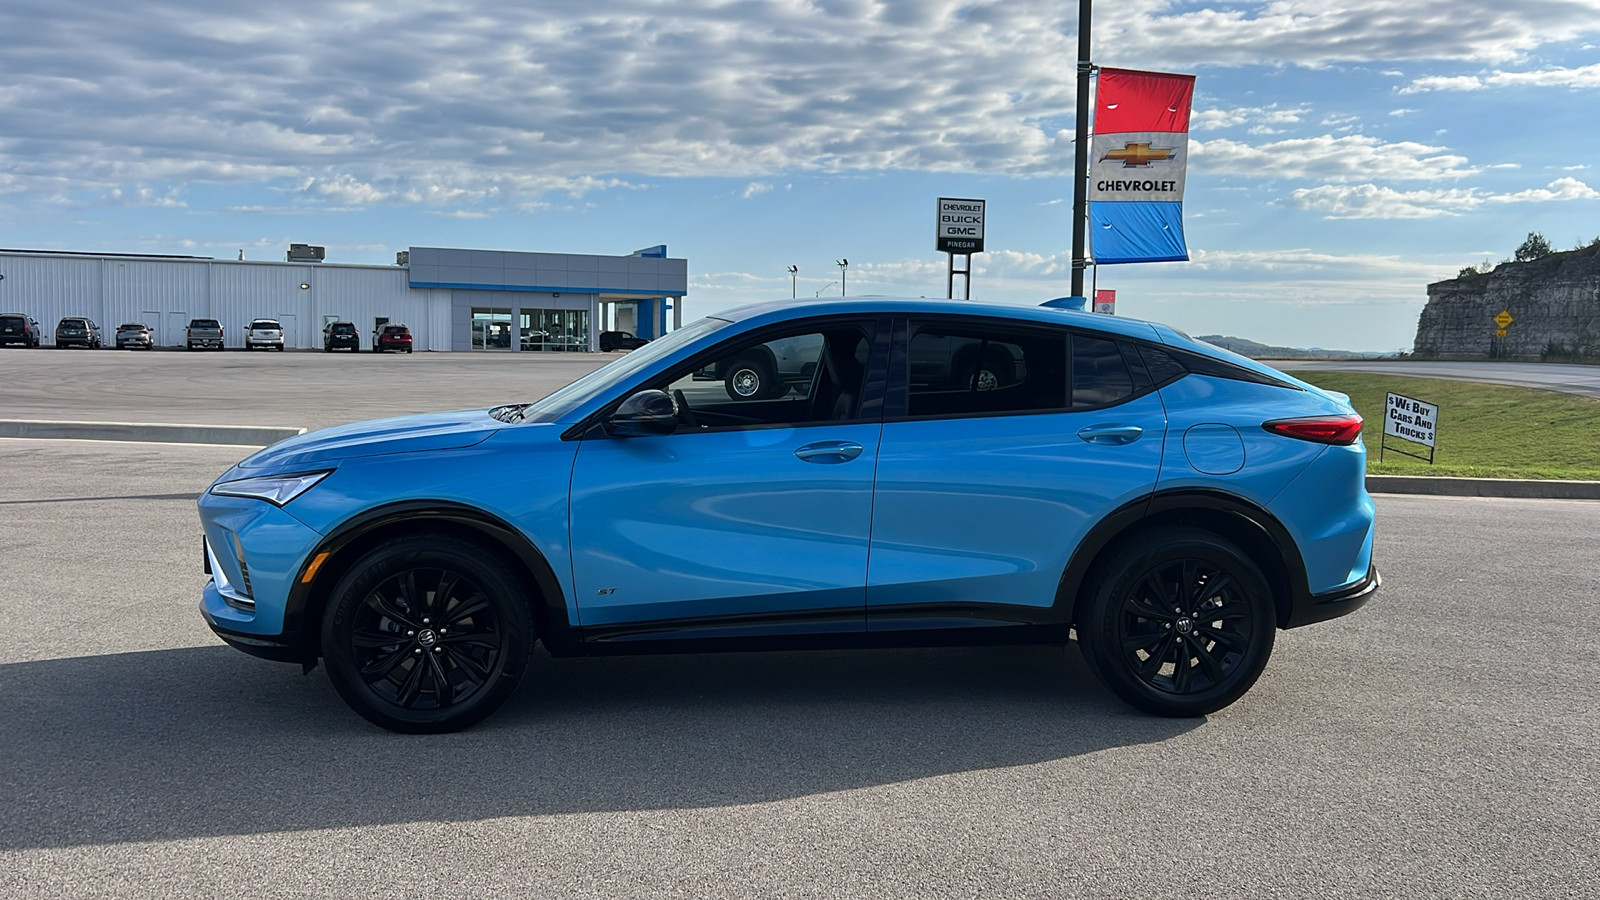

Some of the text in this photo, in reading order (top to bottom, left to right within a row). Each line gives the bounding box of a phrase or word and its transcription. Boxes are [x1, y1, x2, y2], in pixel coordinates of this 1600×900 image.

[943, 203, 981, 212] CHEVROLET
[942, 215, 981, 224] BUICK
[947, 227, 976, 235] GMC
[597, 587, 618, 595] ST
